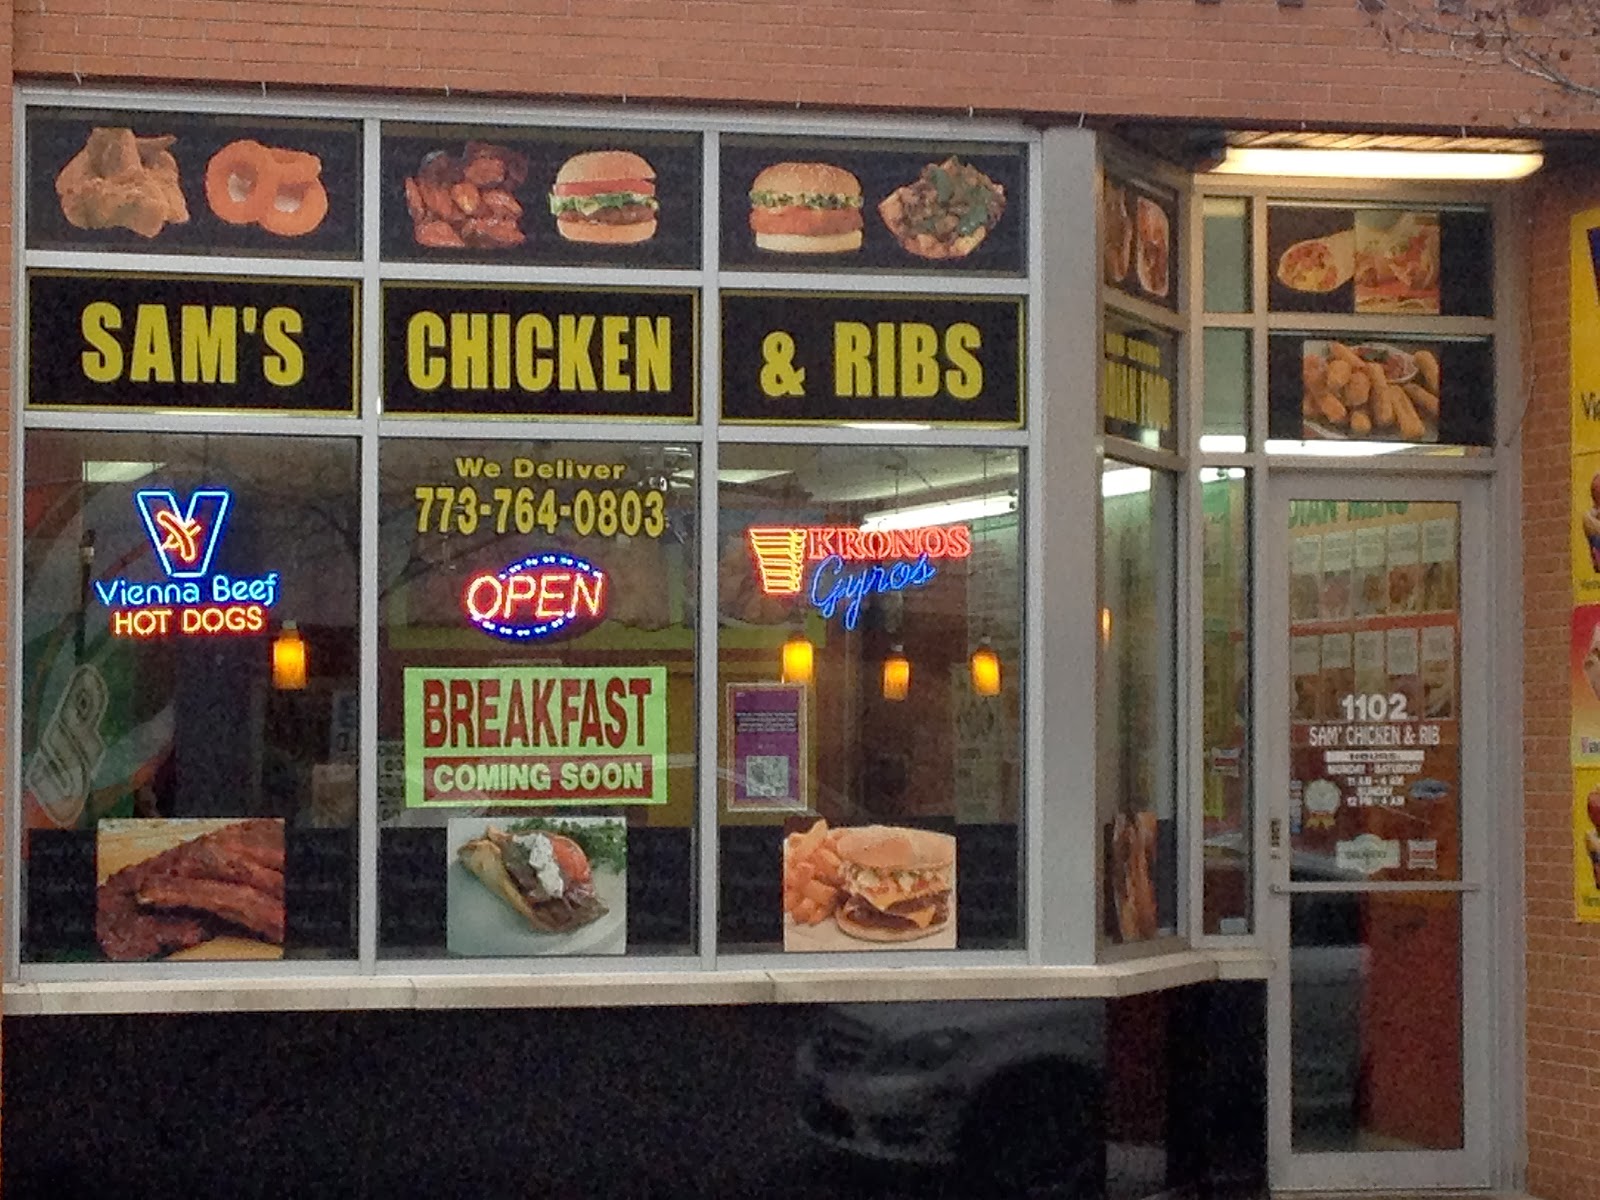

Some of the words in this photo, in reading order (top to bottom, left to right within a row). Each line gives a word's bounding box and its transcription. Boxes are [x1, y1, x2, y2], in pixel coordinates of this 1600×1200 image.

[81, 302, 305, 387] SAM'S
[407, 311, 673, 393] CHICKEN
[760, 331, 806, 397] &
[835, 321, 983, 400] RIBS
[456, 456, 500, 479] We
[514, 458, 625, 480] Deliver
[415, 485, 665, 538] 773-764-0803
[808, 525, 972, 559] KRONOS
[95, 579, 200, 605] Vienna
[213, 573, 279, 606] Beef
[466, 572, 604, 619] OPEN
[811, 552, 935, 630] Gyros
[114, 609, 173, 635] HOT
[183, 606, 263, 633] DOGS
[424, 677, 652, 748] BREAKFAST
[1341, 693, 1408, 721] 1102
[1346, 725, 1401, 746] CHICKEN
[1404, 724, 1416, 745] &
[1419, 724, 1440, 745] RIB
[433, 762, 551, 792] COMING
[560, 761, 644, 790] SOON
